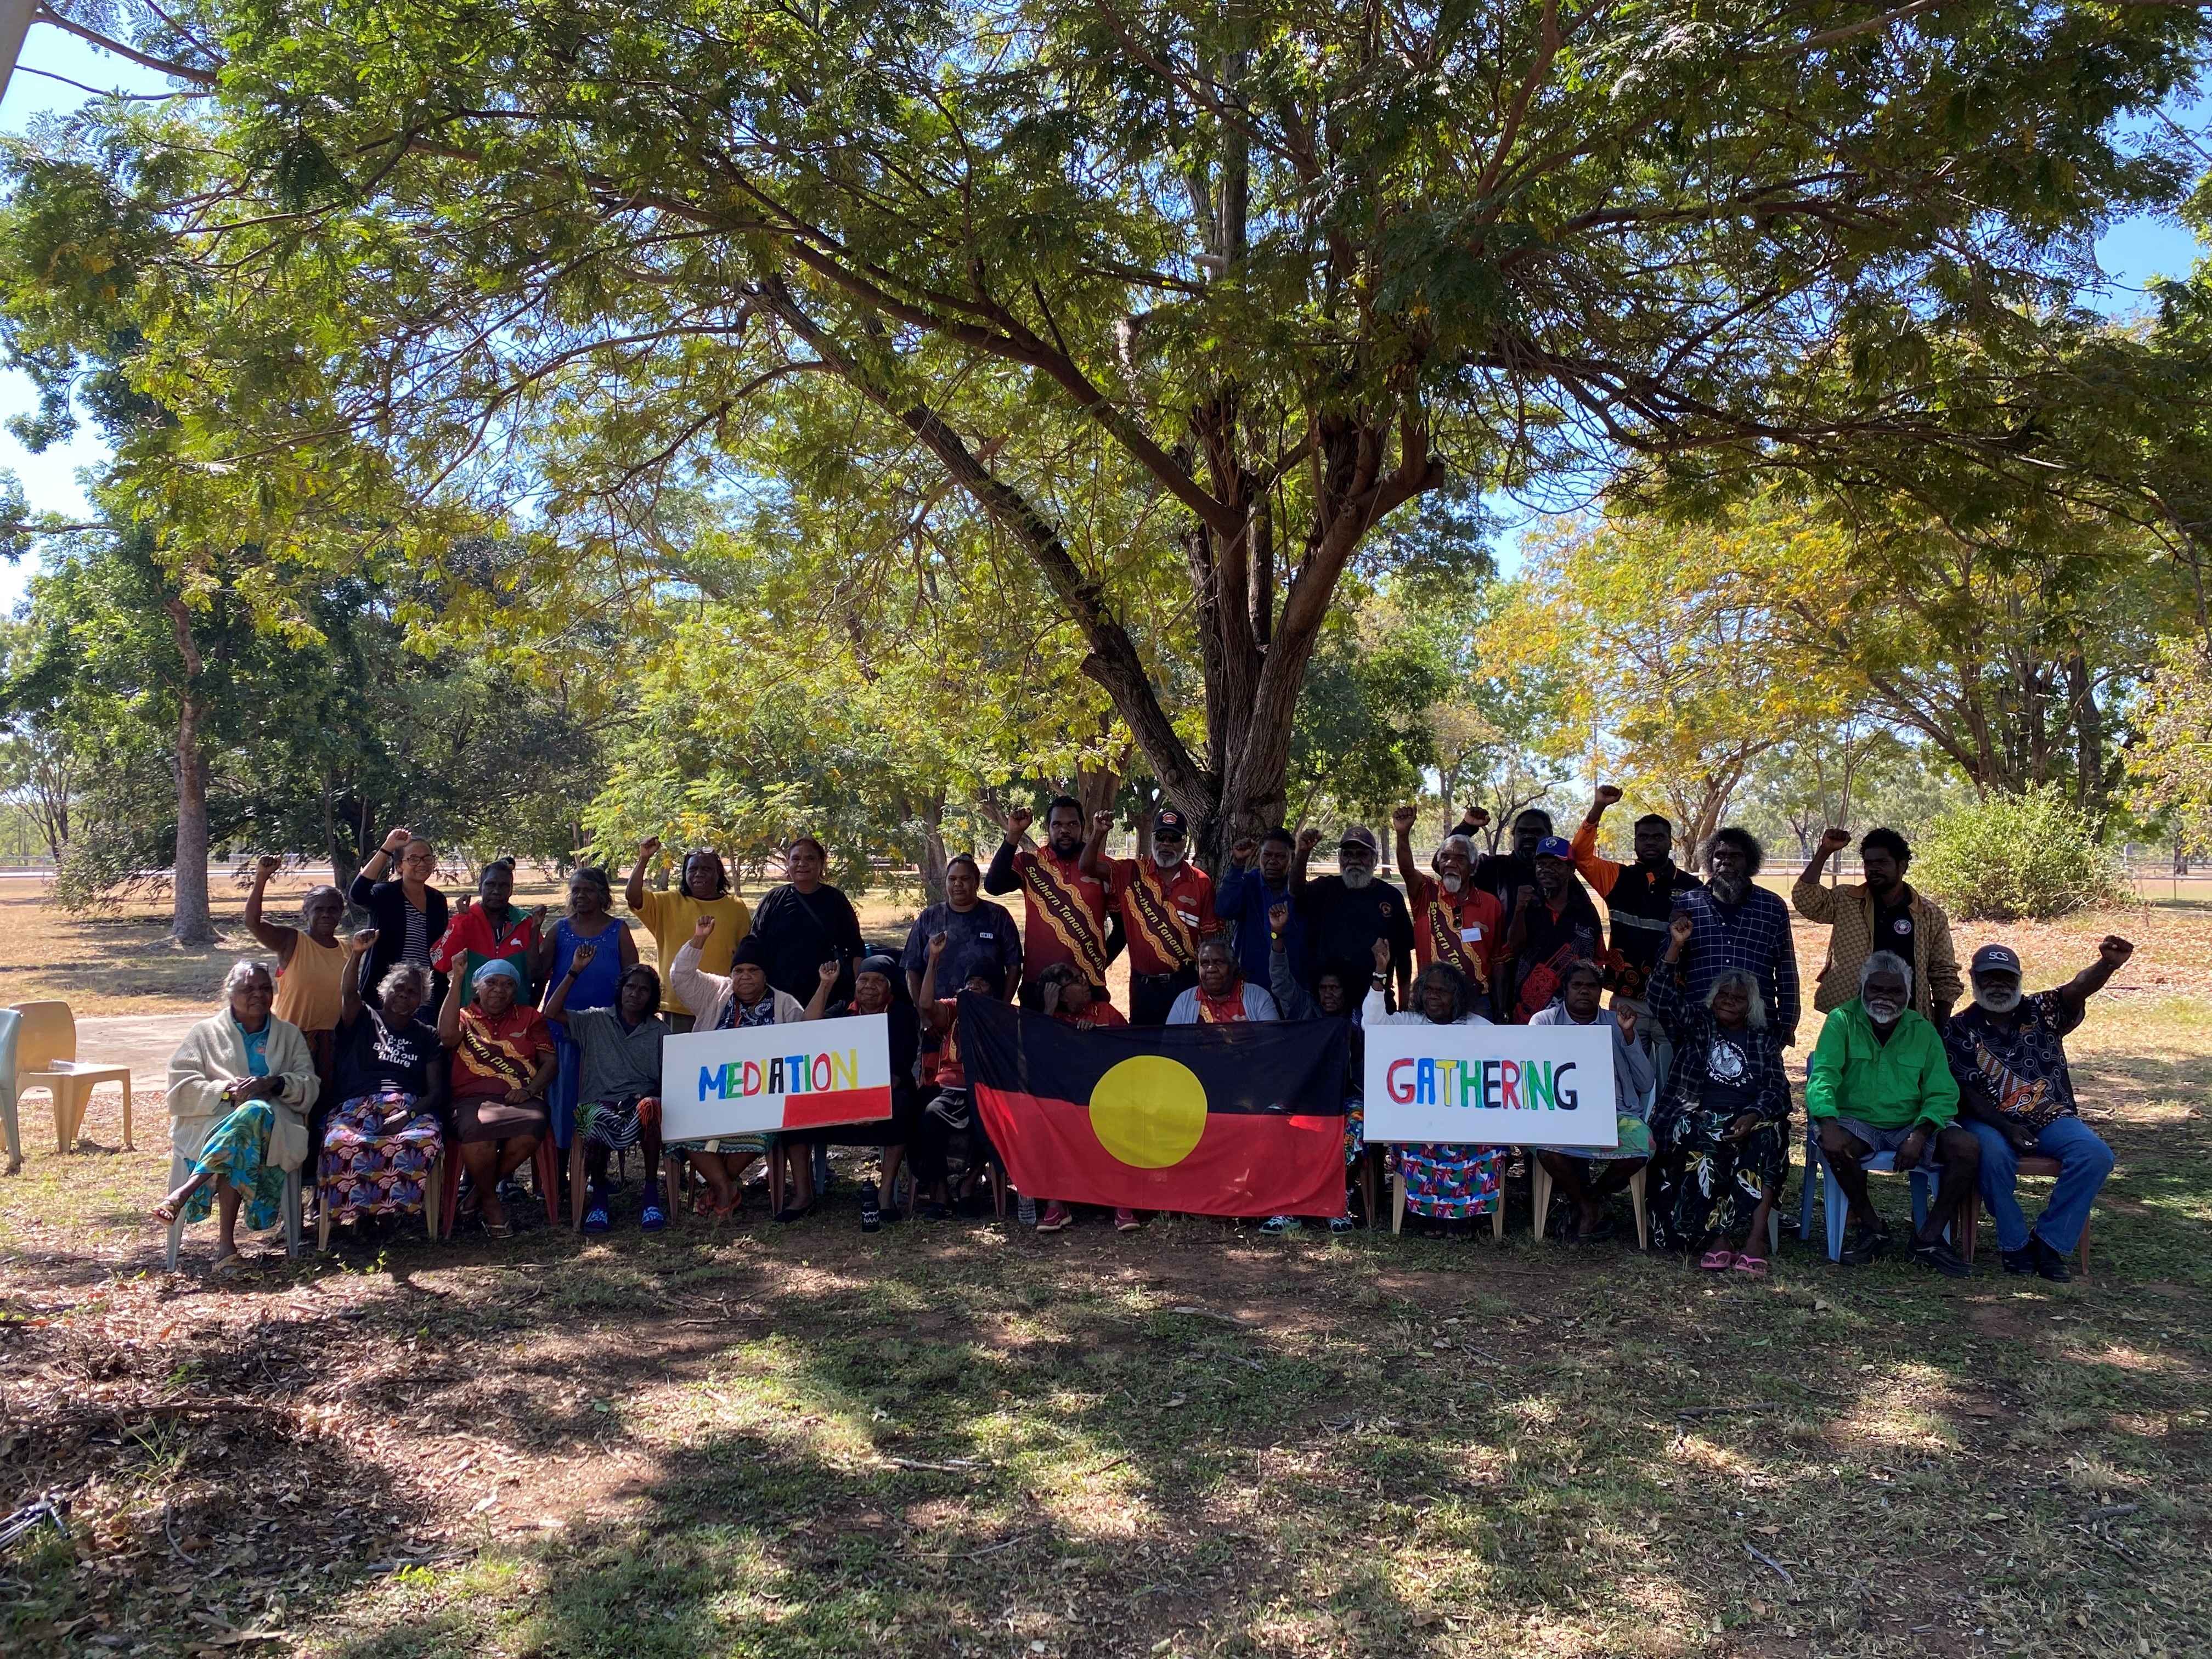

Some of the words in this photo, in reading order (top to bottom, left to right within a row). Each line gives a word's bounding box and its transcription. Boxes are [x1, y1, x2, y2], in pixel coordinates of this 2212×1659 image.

[1025, 866, 1060, 906] Southern
[1059, 904, 1089, 940] Tanami
[1157, 922, 1186, 957] Tanami
[1989, 951, 2009, 962] SCS
[698, 1048, 859, 1102] MEDIATION
[1386, 1057, 1578, 1110] GATHERING
